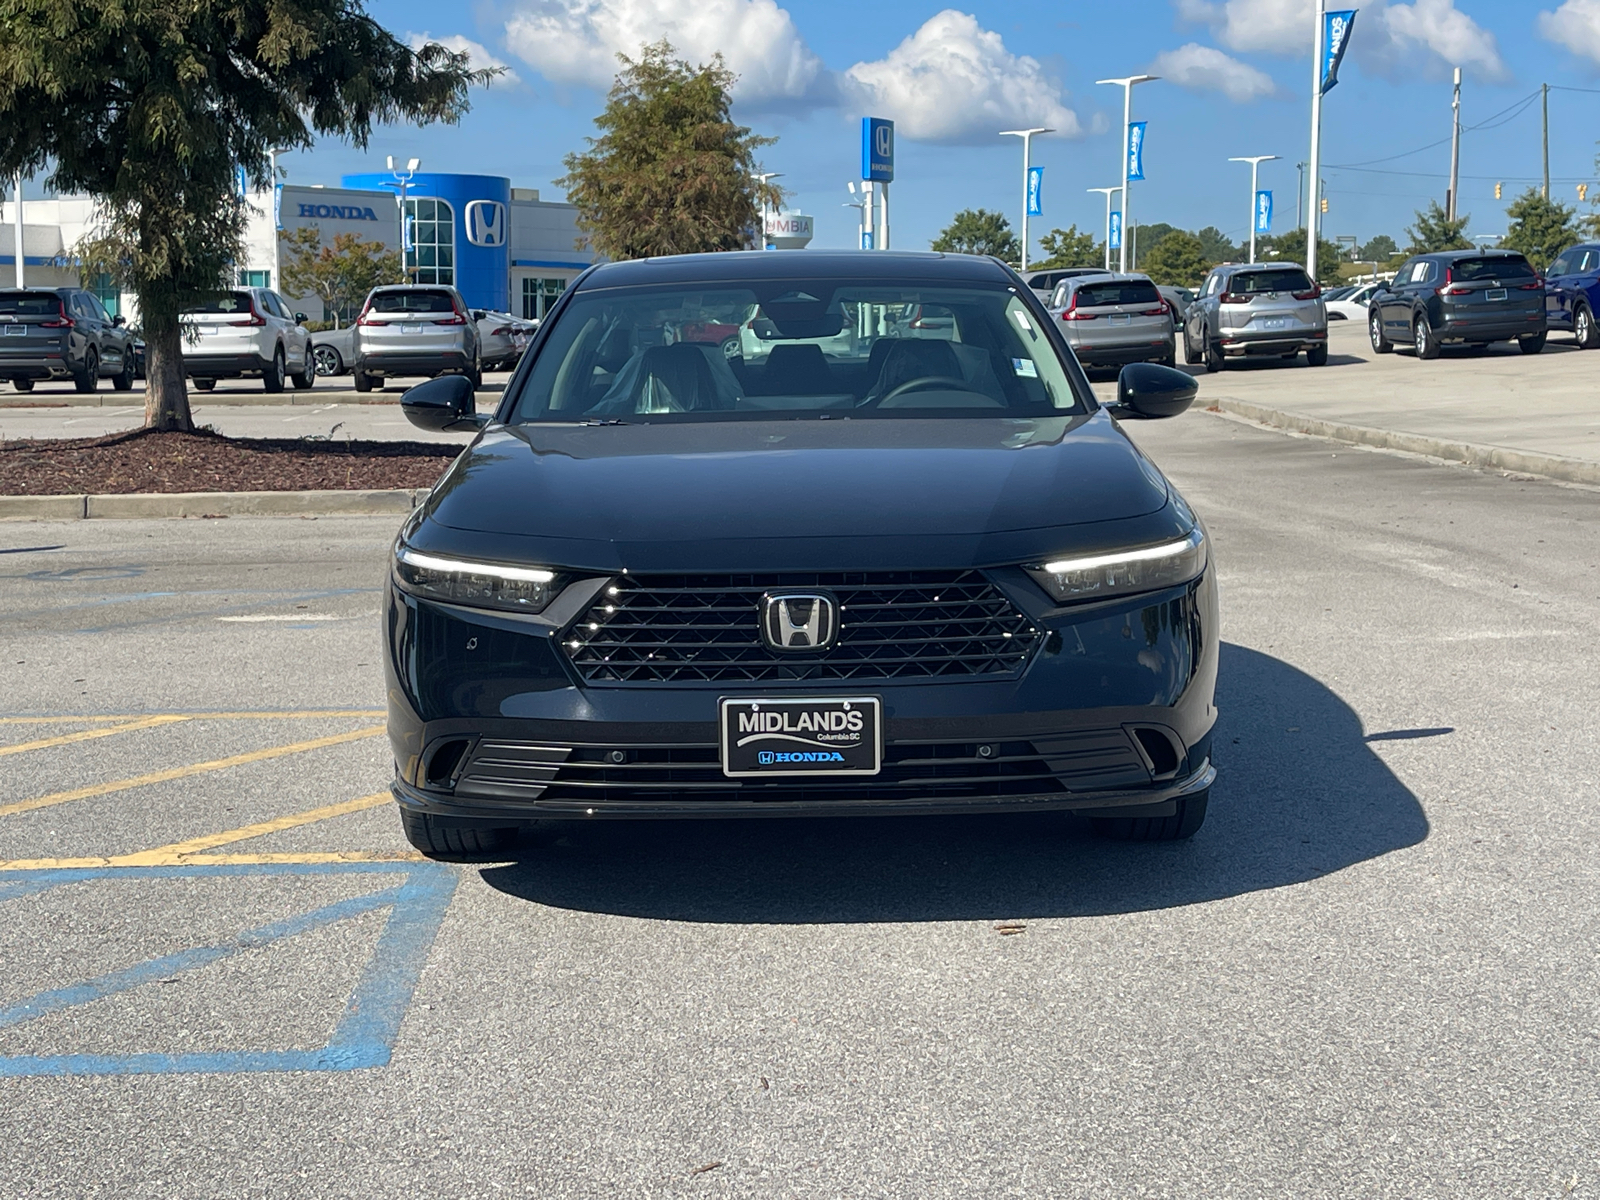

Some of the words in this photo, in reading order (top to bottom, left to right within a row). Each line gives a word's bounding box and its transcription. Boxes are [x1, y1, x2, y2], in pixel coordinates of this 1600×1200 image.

[299, 203, 378, 221] HONDA
[766, 220, 810, 233] UMBIA
[739, 711, 863, 732] MIDLANDS
[817, 733, 849, 741] Columbia
[776, 752, 844, 762] HONDA
